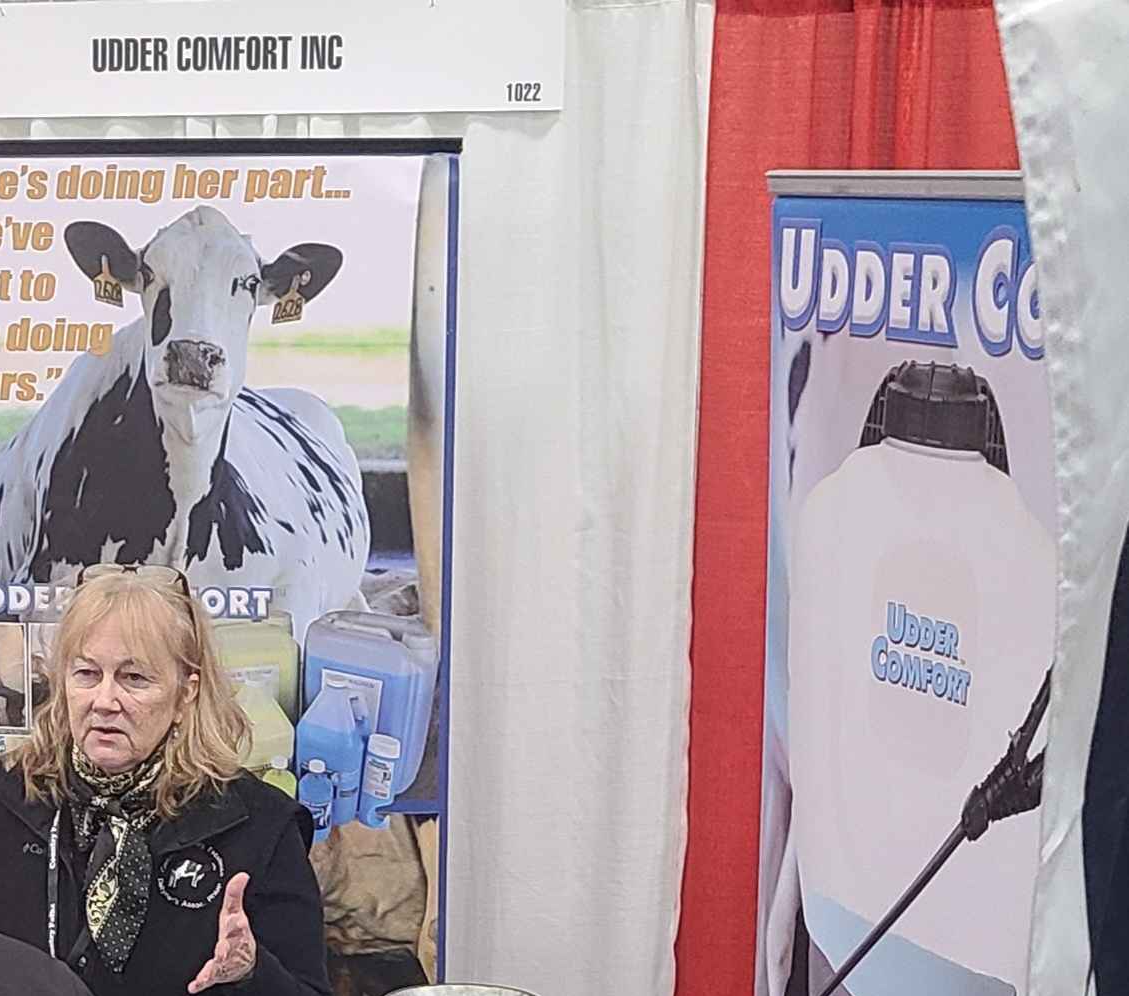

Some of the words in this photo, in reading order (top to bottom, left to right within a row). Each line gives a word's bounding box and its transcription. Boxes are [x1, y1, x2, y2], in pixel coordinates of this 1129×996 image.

[92, 38, 168, 73] UDDER
[175, 36, 293, 71] COMFORT
[299, 35, 344, 70] INC
[505, 82, 542, 103] 1022
[56, 164, 164, 203] doing
[172, 165, 237, 199] her
[244, 166, 352, 205] part...
[19, 271, 57, 301] to
[779, 226, 951, 334] UDDER
[6, 316, 113, 357] doing
[887, 602, 959, 660] UDDER
[872, 636, 972, 706] COMFORT
